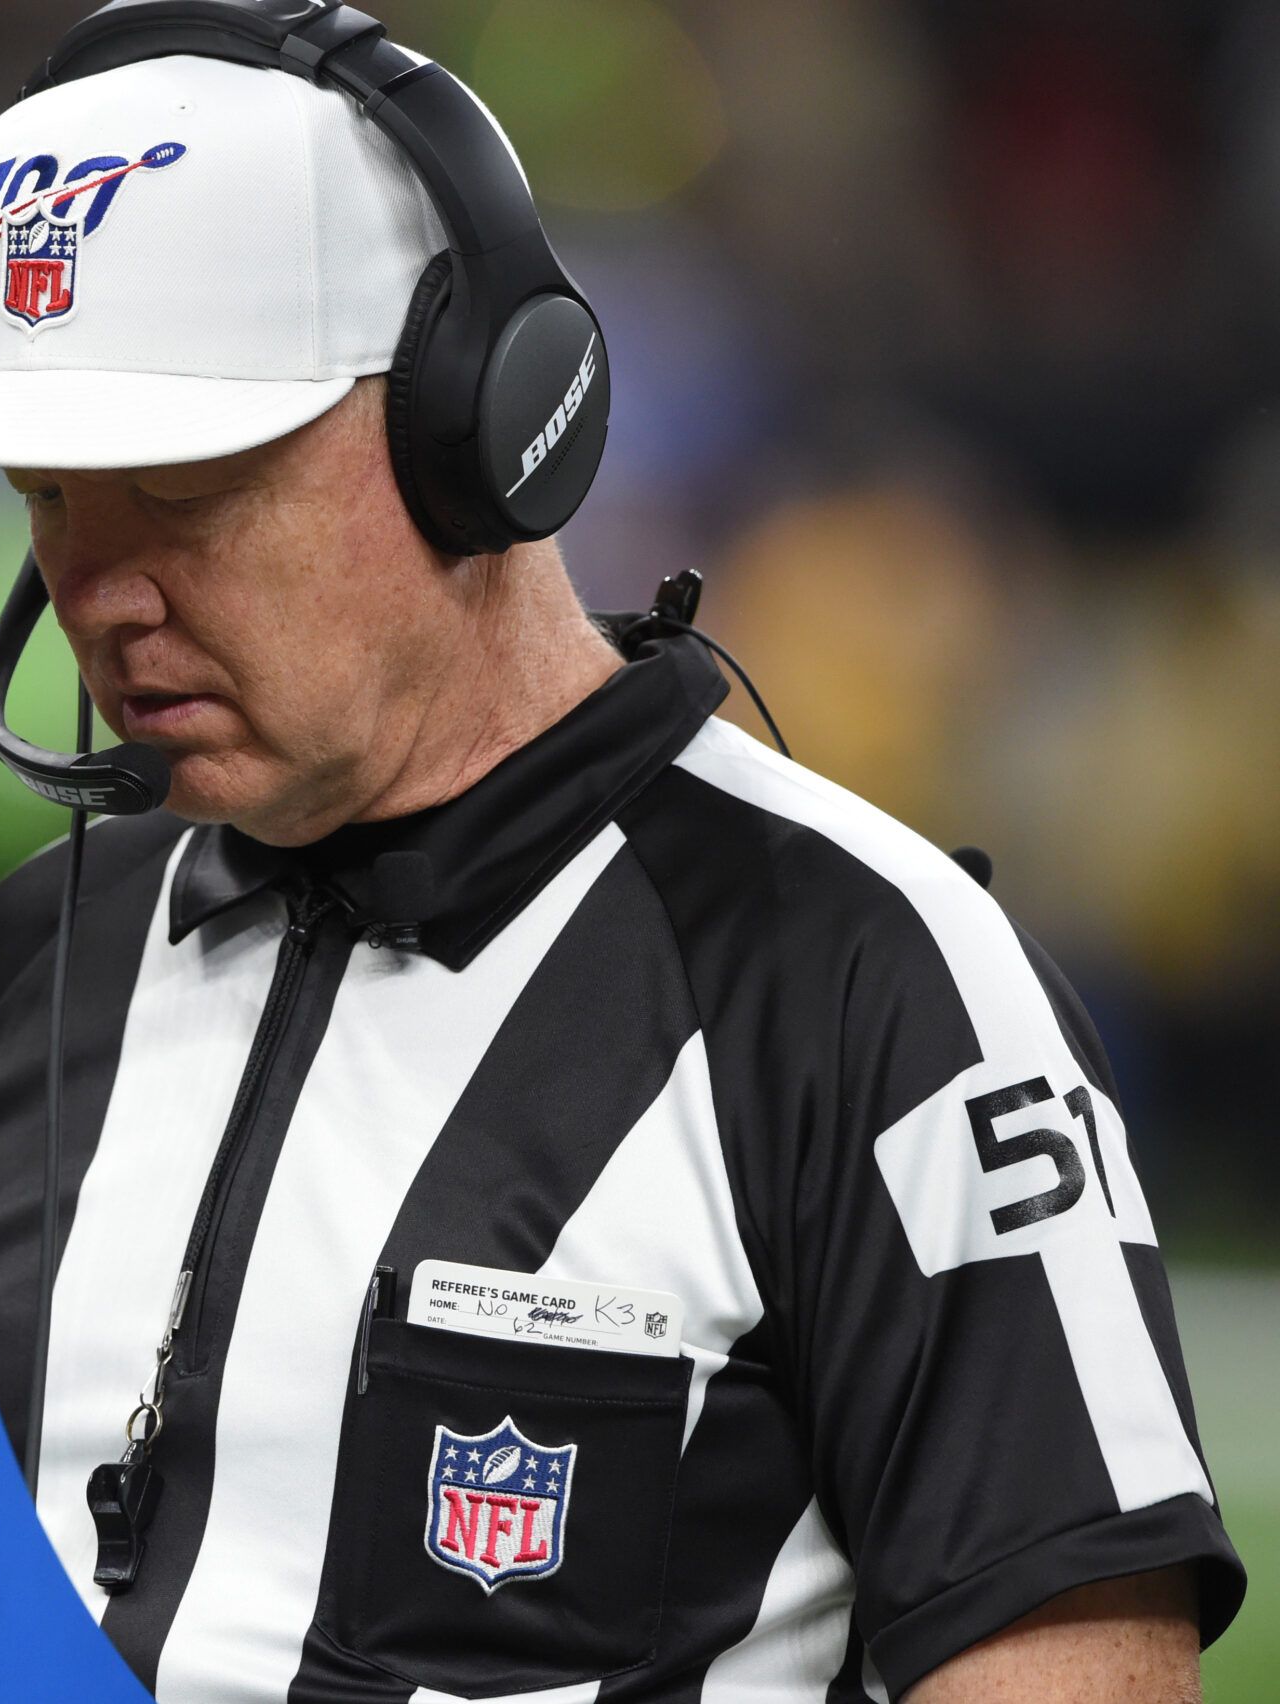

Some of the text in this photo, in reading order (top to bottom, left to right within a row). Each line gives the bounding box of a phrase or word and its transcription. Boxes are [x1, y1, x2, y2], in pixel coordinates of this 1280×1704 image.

[4, 259, 73, 319] NFL
[505, 331, 596, 498] BOSE
[964, 1075, 1116, 1236] 51
[429, 1298, 460, 1311] HOME:
[432, 1279, 576, 1310] REFEREE'S GAME CARD
[427, 1315, 447, 1325] DATE:
[646, 1323, 665, 1336] NFL
[543, 1332, 599, 1346] GAME NUMBER:
[439, 1488, 548, 1568] NFL
